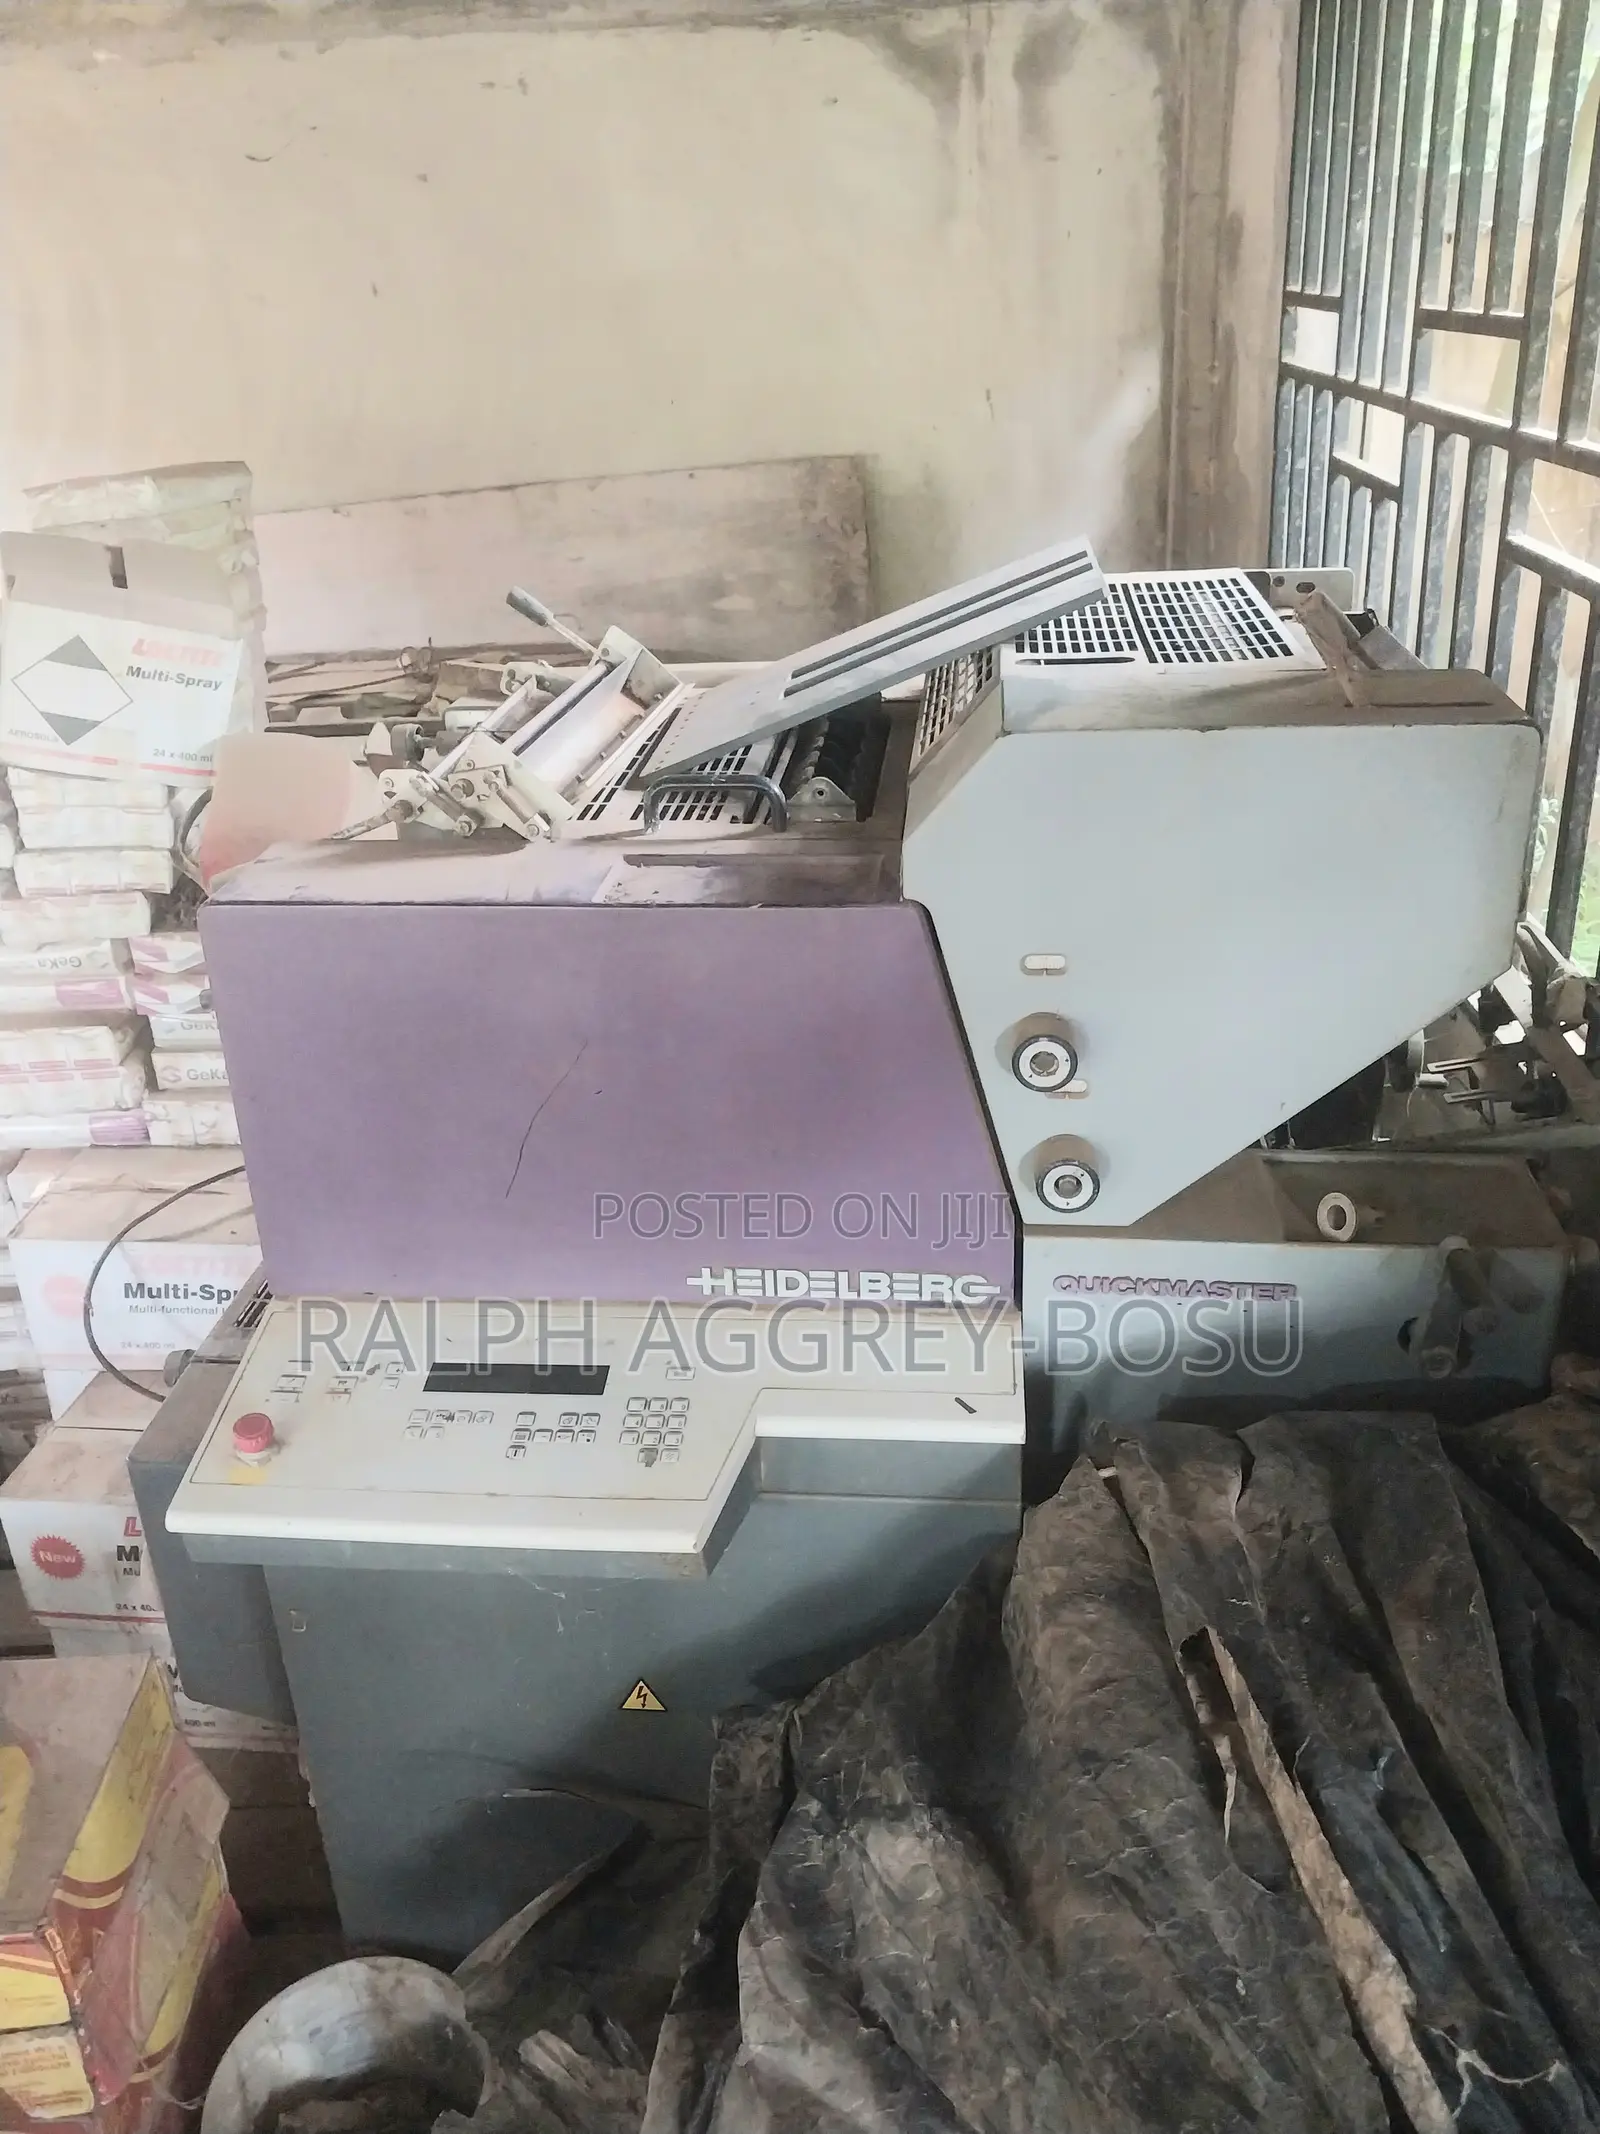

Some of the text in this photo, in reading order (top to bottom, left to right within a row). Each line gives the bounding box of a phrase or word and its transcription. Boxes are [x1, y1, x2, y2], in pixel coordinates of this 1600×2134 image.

[125, 664, 223, 691] Multi-Spray
[686, 1267, 1001, 1305] HEIDELBERG
[1053, 1275, 1298, 1301] QUICKMASTER
[39, 1550, 76, 1563] New
